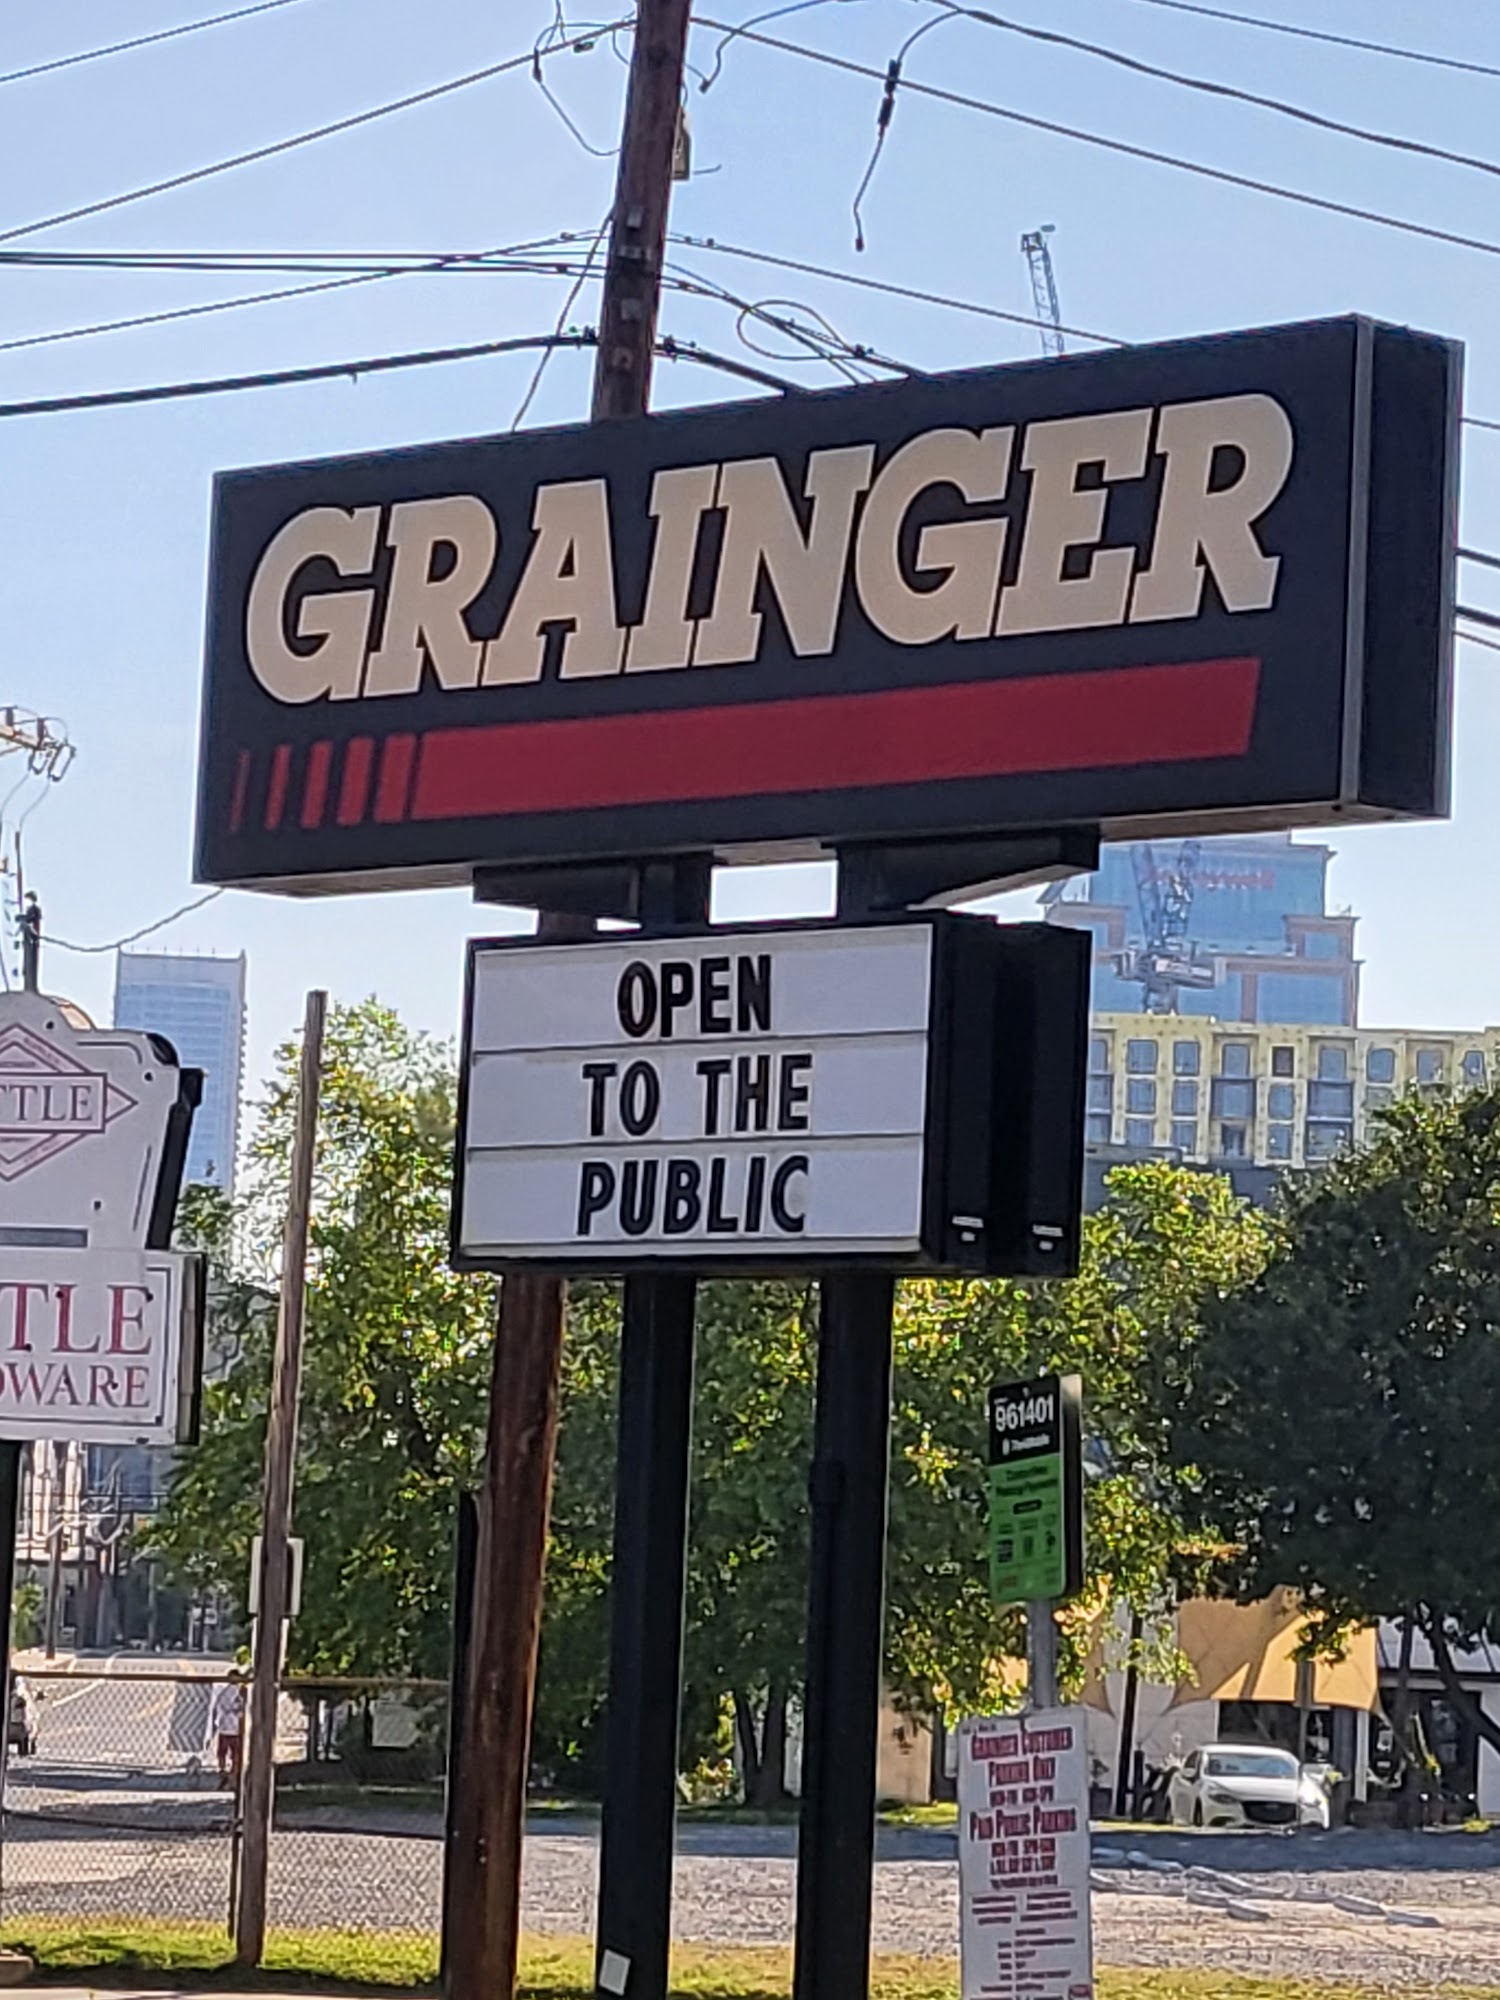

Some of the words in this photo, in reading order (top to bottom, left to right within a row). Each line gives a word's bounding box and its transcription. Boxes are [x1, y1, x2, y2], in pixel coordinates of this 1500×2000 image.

[246, 393, 1295, 705] GRAINGER
[617, 954, 771, 1037] OPEN
[0, 1085, 93, 1122] TLE
[582, 1060, 660, 1137] TO
[697, 1053, 812, 1136] THE
[577, 1156, 810, 1236] PUBLIC
[0, 1363, 150, 1408] WARE
